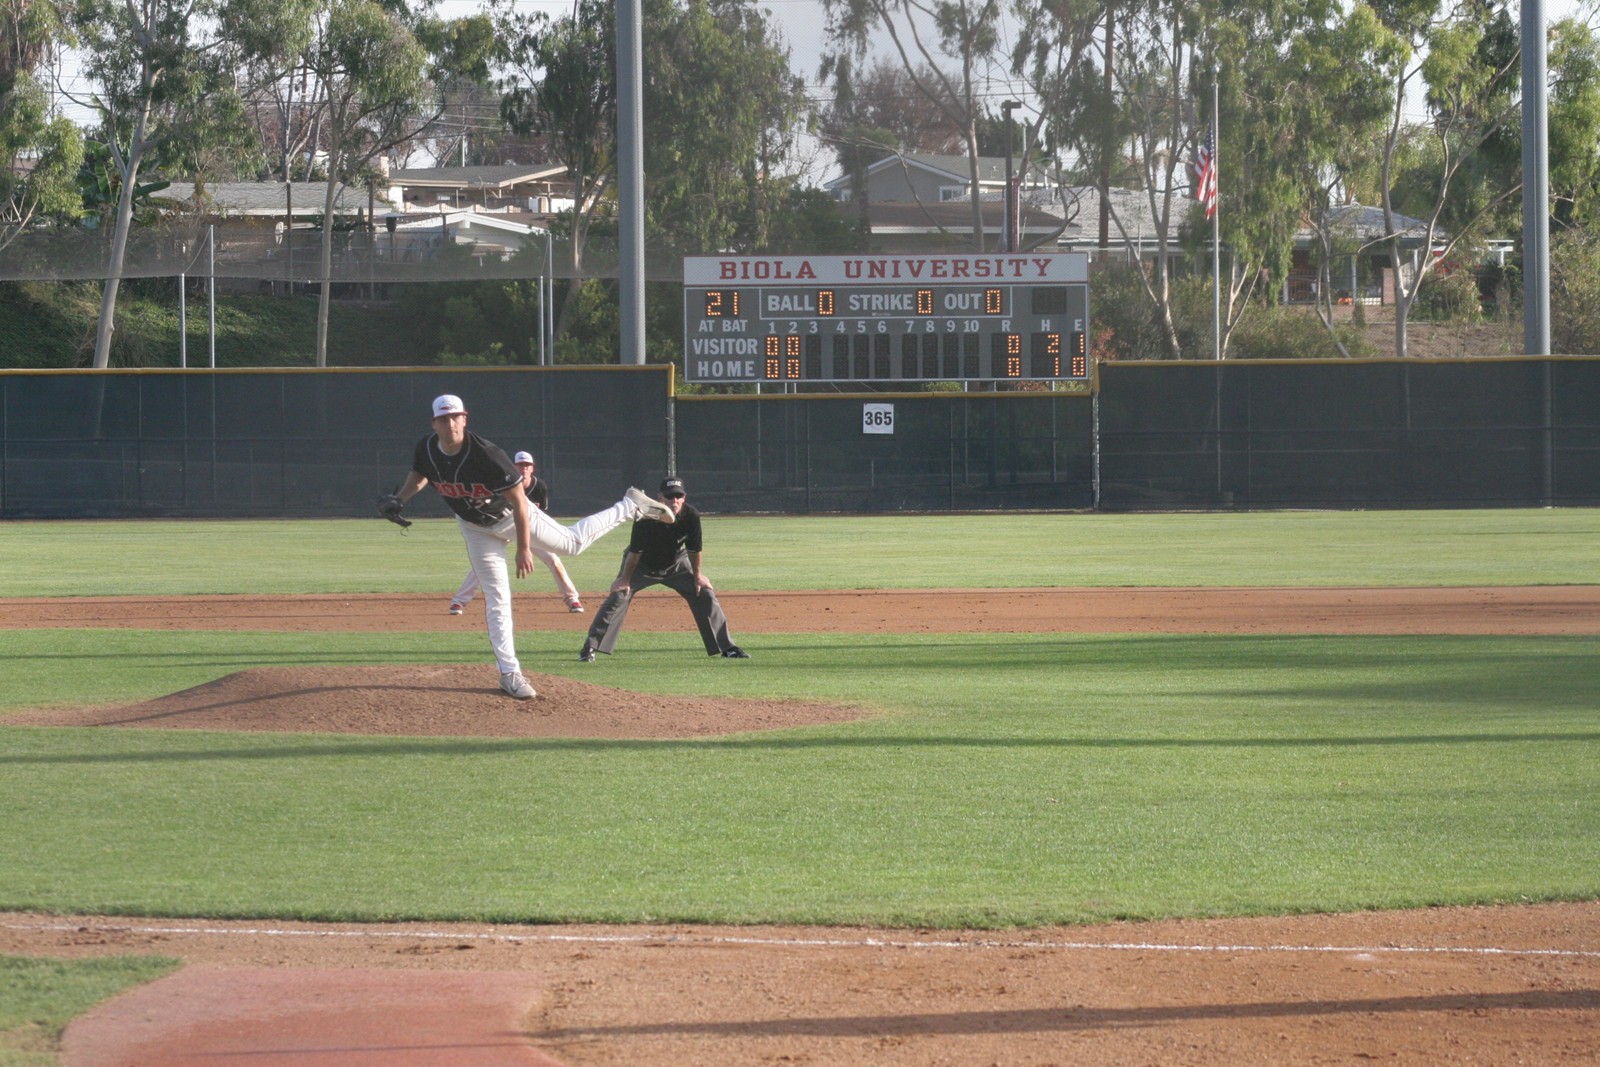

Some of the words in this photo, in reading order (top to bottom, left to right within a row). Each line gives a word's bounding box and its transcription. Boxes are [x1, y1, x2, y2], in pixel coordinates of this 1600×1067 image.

[719, 260, 817, 280] BIOLA
[842, 258, 1053, 279] UNIVERSITY
[706, 291, 740, 316] 21
[767, 295, 814, 312] BALL
[818, 290, 833, 315] 0
[849, 293, 914, 311] STRIKE
[917, 290, 932, 314] 0
[944, 293, 983, 310] OUT
[986, 289, 1001, 313] 0
[698, 319, 714, 333] AT
[722, 319, 748, 332] BAT
[768, 322, 776, 334] 1
[788, 321, 798, 334] 2
[809, 321, 818, 333] 3
[836, 321, 846, 333] 4
[857, 321, 866, 333] 5
[877, 320, 887, 333] 6
[905, 320, 915, 332] 7
[925, 320, 935, 332] 8
[946, 320, 956, 332] 9
[963, 320, 979, 332] 10
[1001, 320, 1011, 332] R
[1041, 319, 1050, 332] H
[1074, 319, 1082, 331] E
[692, 338, 758, 355] VISITOR
[766, 336, 779, 356] 0
[787, 336, 799, 356] 0
[1008, 335, 1020, 354] 0
[1047, 334, 1060, 354] 2
[697, 360, 755, 378] HOME
[766, 359, 779, 379] 0
[787, 359, 799, 378] 0
[1008, 357, 1020, 376] 0
[1072, 356, 1085, 376] 0
[864, 411, 893, 426] 365
